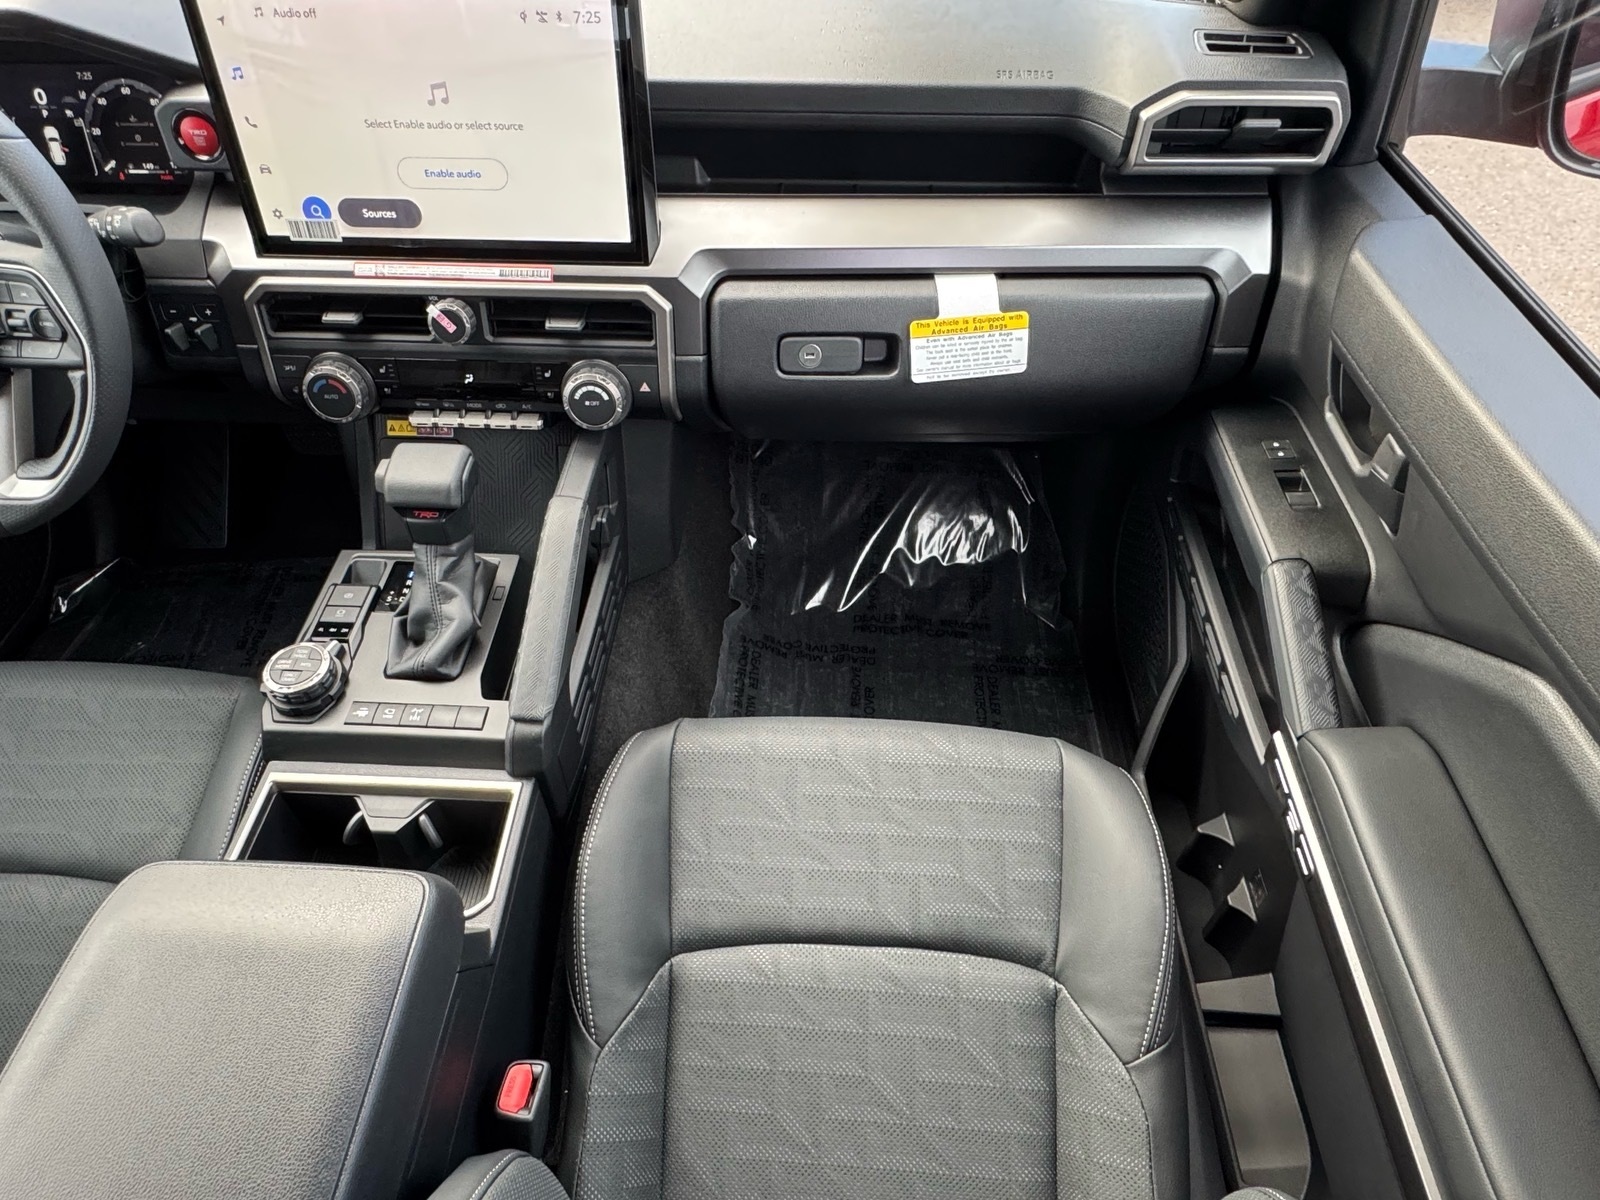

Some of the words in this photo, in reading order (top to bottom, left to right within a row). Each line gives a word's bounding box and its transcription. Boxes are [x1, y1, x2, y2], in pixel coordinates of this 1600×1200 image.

[272, 8, 301, 19] Audio
[303, 8, 317, 19] off
[572, 10, 602, 25] 7:25
[76, 71, 93, 80] 7:25
[996, 69, 1013, 79] SRS
[1016, 69, 1054, 80] AIRBAG
[33, 87, 48, 105] 0
[121, 86, 131, 95] 60
[97, 97, 107, 106] 40
[364, 119, 392, 130] Select
[394, 119, 425, 130] Enable
[427, 120, 451, 131] audio
[453, 122, 463, 130] or
[465, 120, 492, 131] select
[494, 123, 524, 131] source
[91, 127, 101, 136] 20
[424, 169, 455, 178] Enable
[456, 169, 482, 179] audio
[362, 208, 397, 219] Sources
[934, 319, 960, 328] Vehicle
[972, 314, 1006, 324] Equipped
[931, 327, 969, 336] Advanced
[989, 323, 1008, 331] Bags
[957, 333, 985, 341] Advanced
[413, 510, 439, 519] TRD
[853, 613, 898, 624] DEALER
[926, 629, 969, 639] COVER
[831, 654, 876, 666] DEALER
[748, 650, 761, 690] DEALER
[745, 695, 757, 717] MUS
[863, 686, 875, 716] OVER
